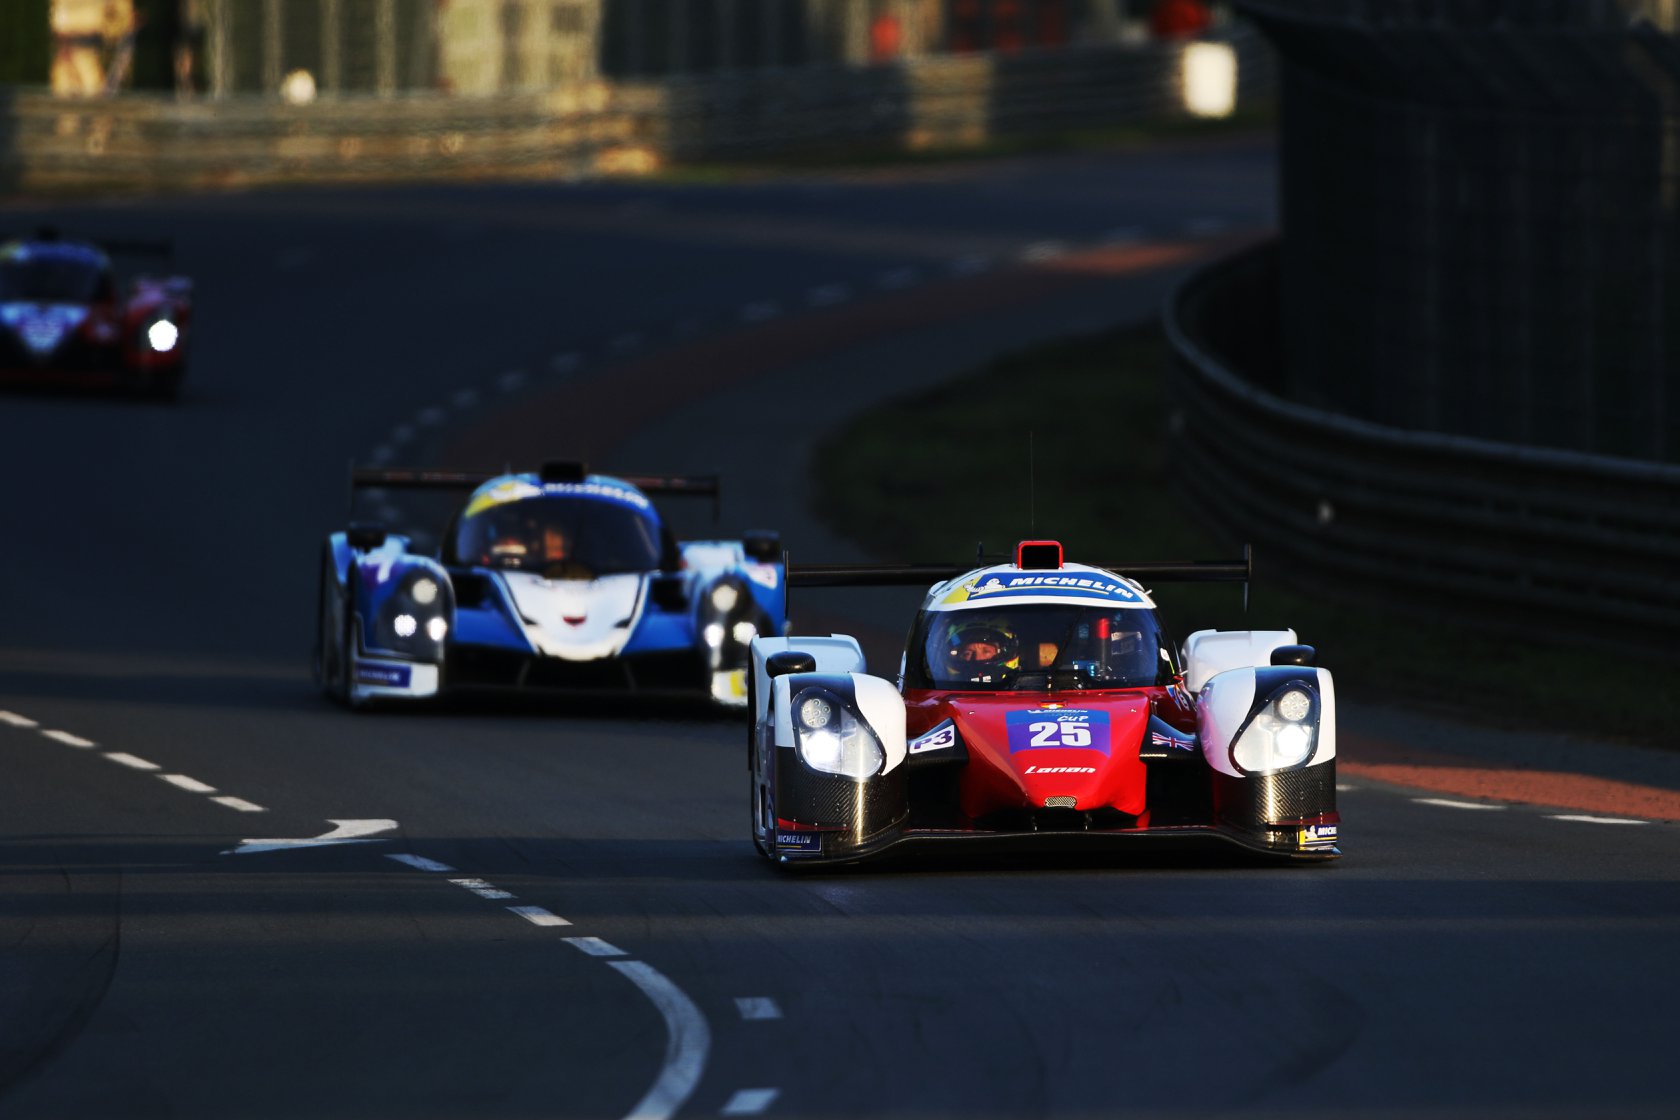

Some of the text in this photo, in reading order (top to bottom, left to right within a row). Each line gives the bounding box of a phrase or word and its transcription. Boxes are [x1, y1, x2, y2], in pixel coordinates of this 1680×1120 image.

[1009, 577, 1134, 599] MICHELIN
[914, 730, 953, 750] P3
[1029, 721, 1092, 747] 25
[1025, 765, 1096, 774] Lanan
